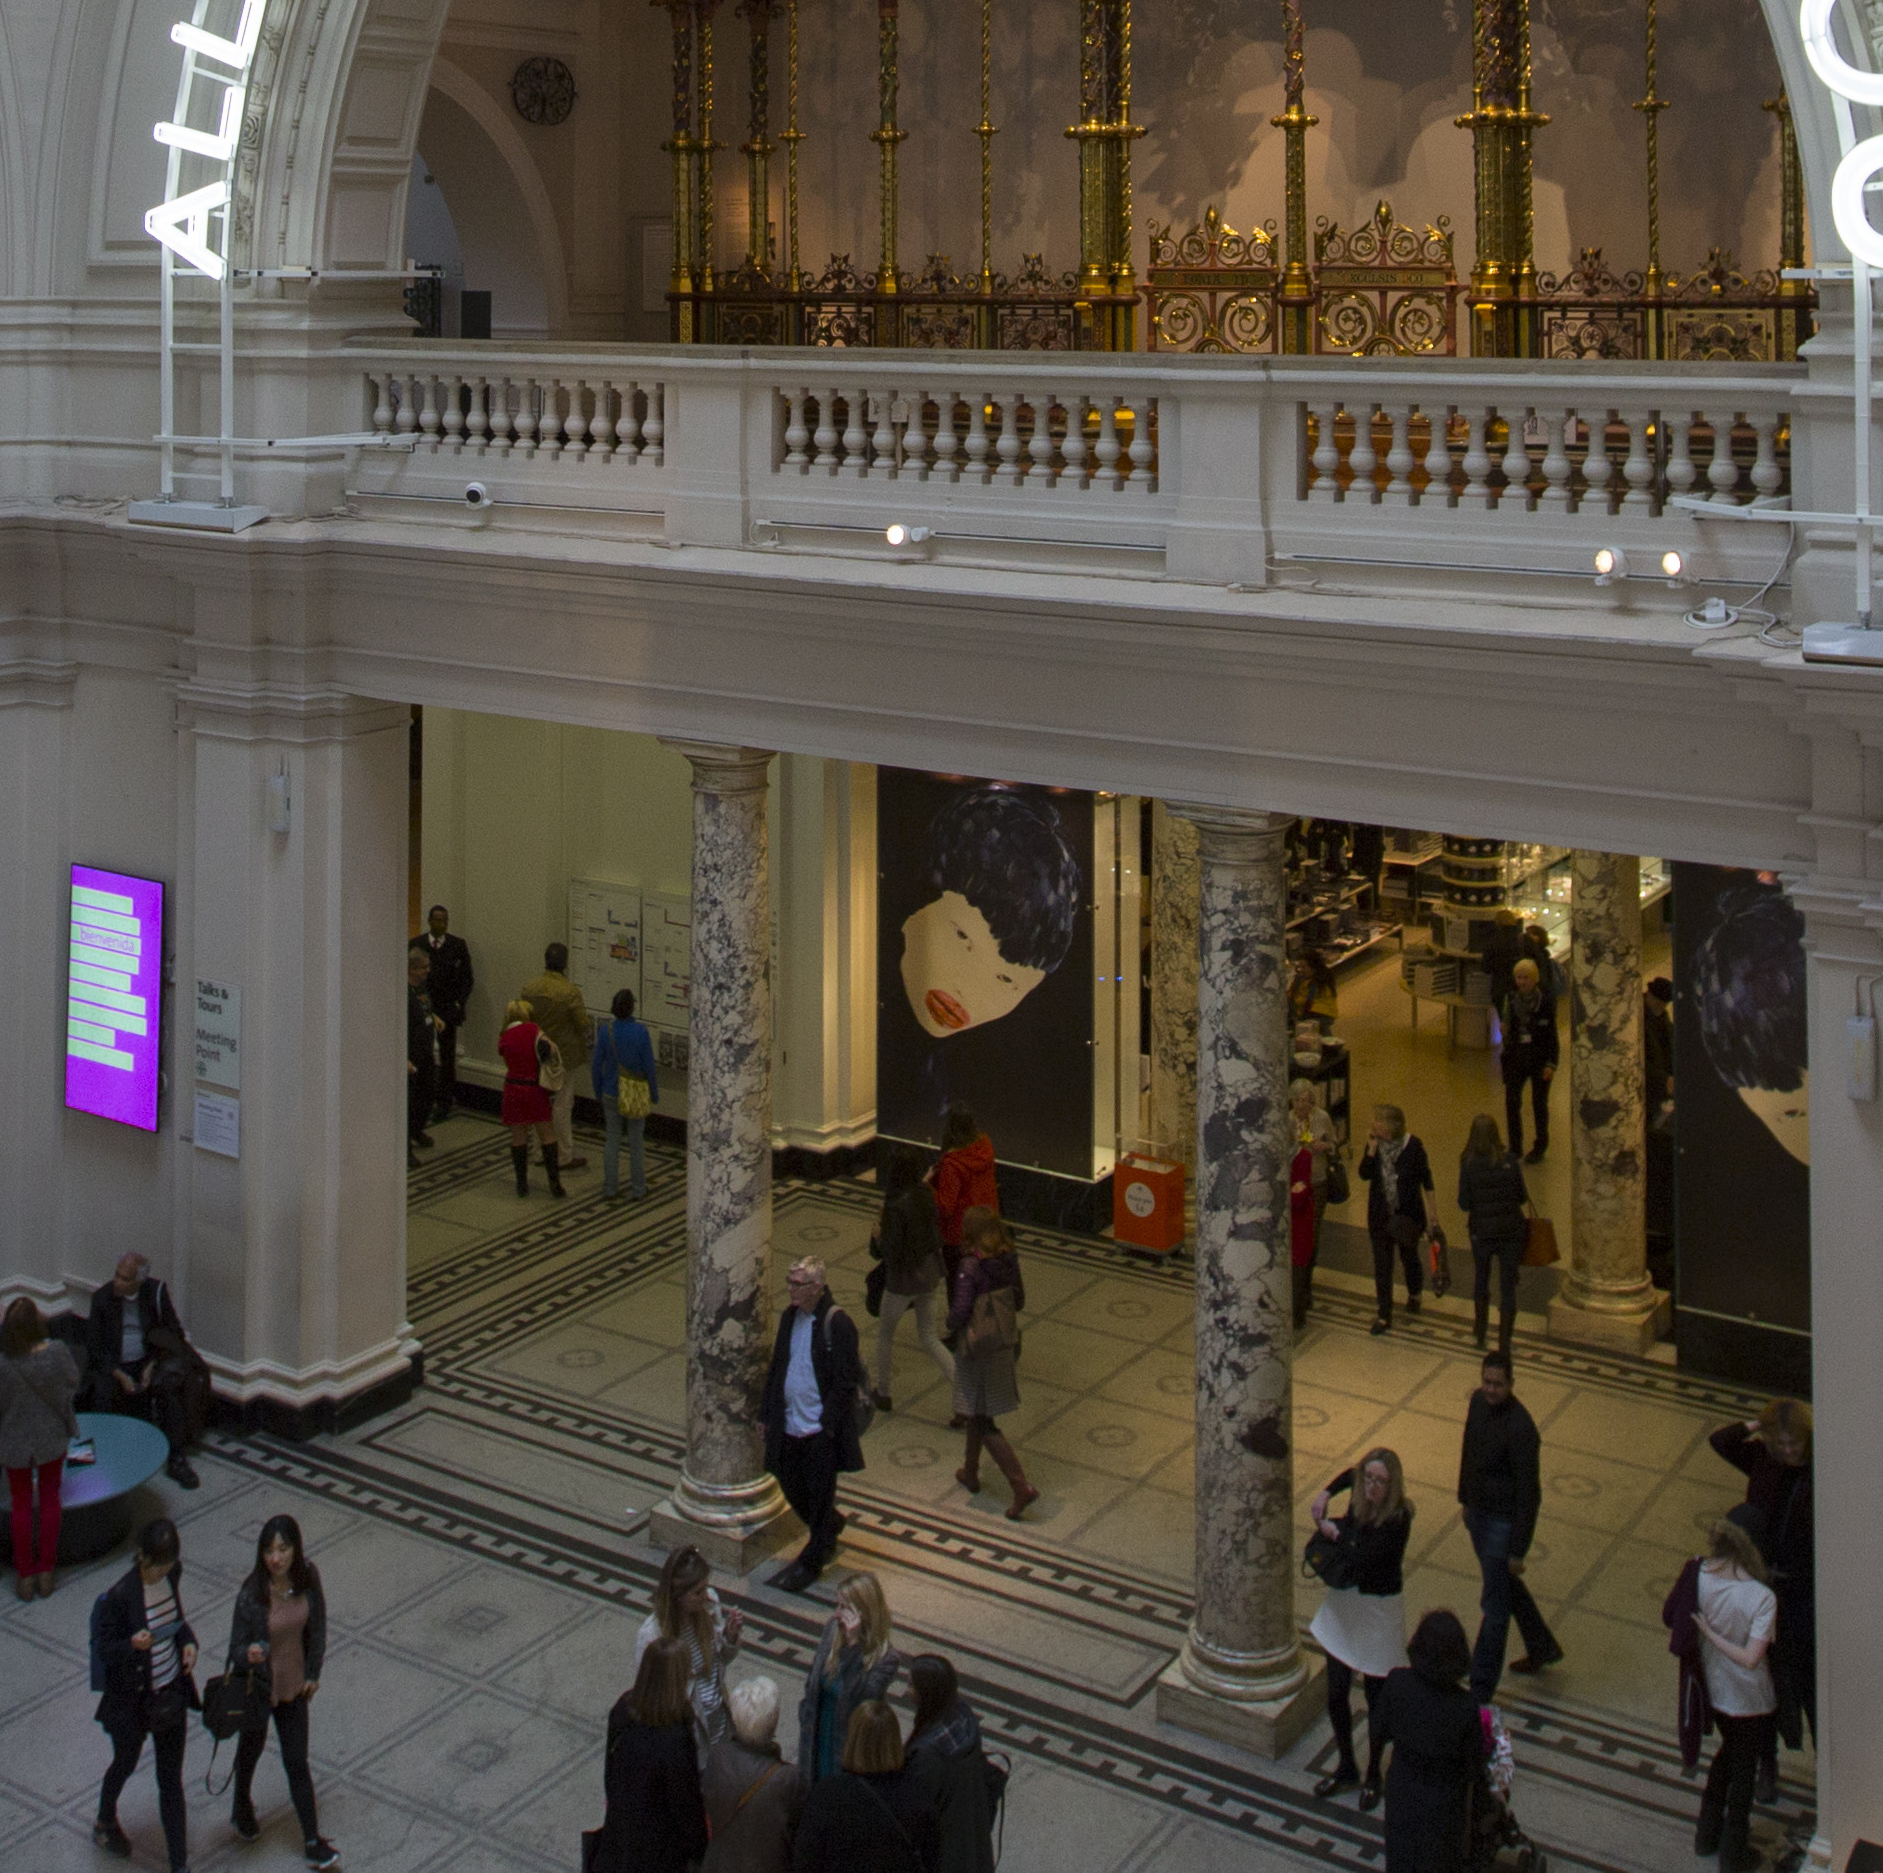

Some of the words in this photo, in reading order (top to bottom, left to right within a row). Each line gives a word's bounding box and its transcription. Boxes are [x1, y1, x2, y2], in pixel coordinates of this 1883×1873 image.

[80, 926, 135, 952] bienvenida
[197, 981, 220, 998] Talks
[221, 988, 229, 1000] &
[197, 997, 222, 1015] Tours
[195, 1029, 237, 1053] Meeting
[196, 1044, 221, 1063] Point
